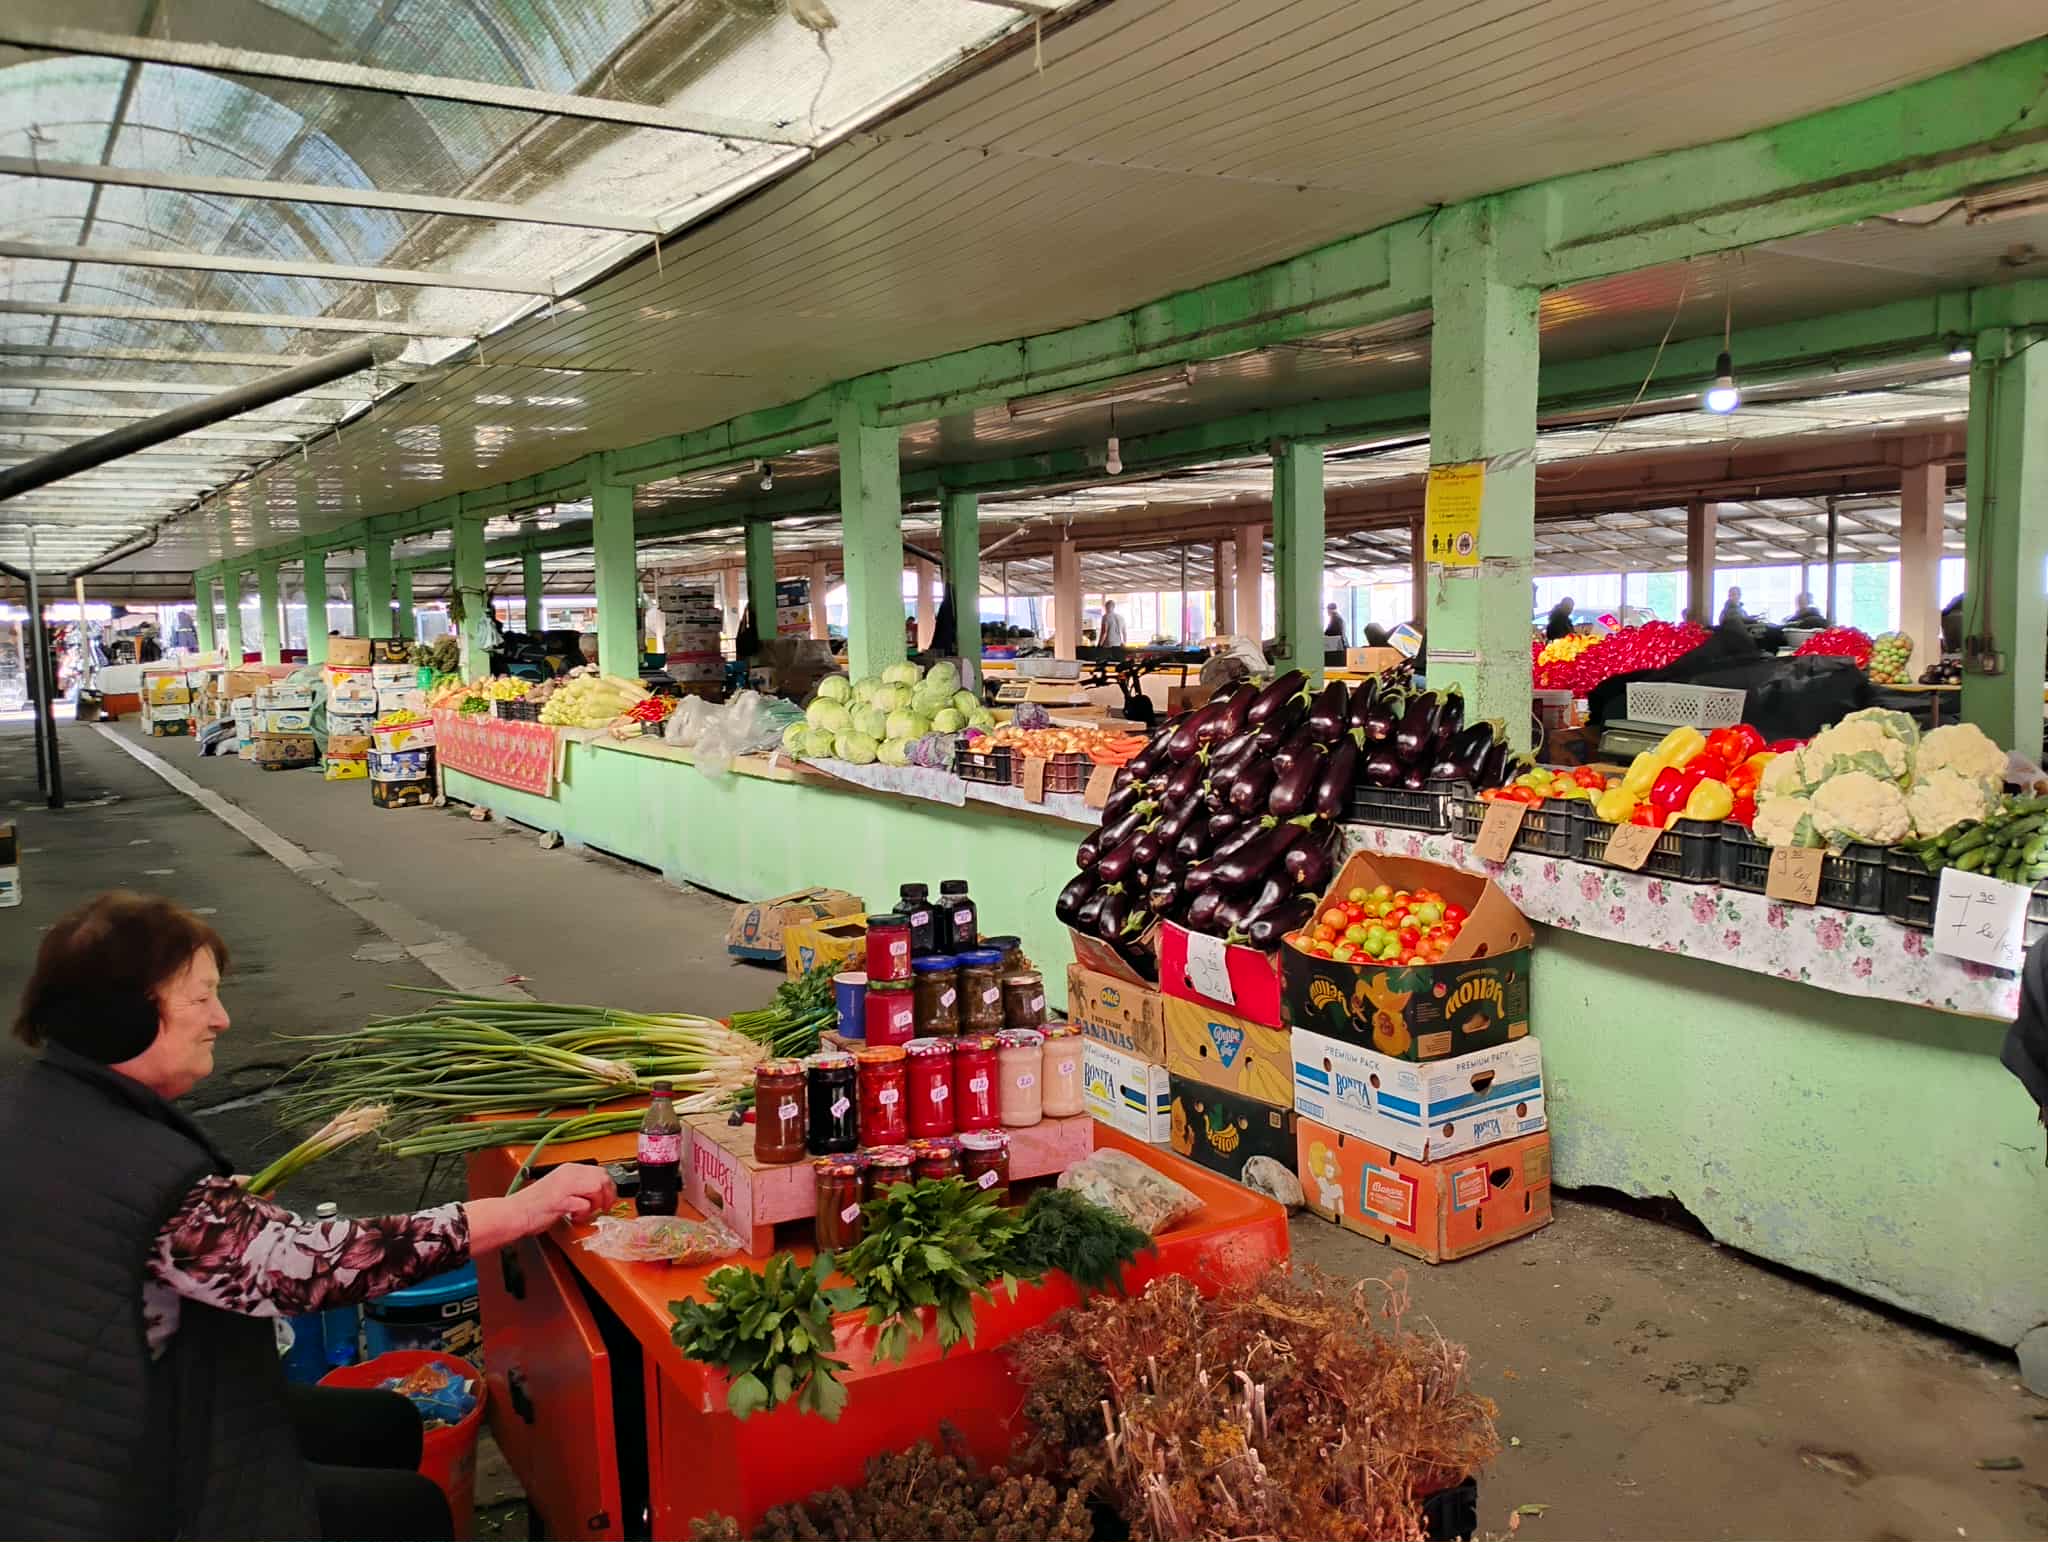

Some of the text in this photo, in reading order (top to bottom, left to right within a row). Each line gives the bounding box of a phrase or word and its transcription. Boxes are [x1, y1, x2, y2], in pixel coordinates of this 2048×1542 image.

[1948, 892, 1973, 937] 7
[1324, 1046, 1381, 1071] PREMIUM PACK
[1456, 1057, 1489, 1072] PREMIUM
[1084, 1062, 1116, 1099] BONITA
[1336, 1072, 1371, 1107] BONITA
